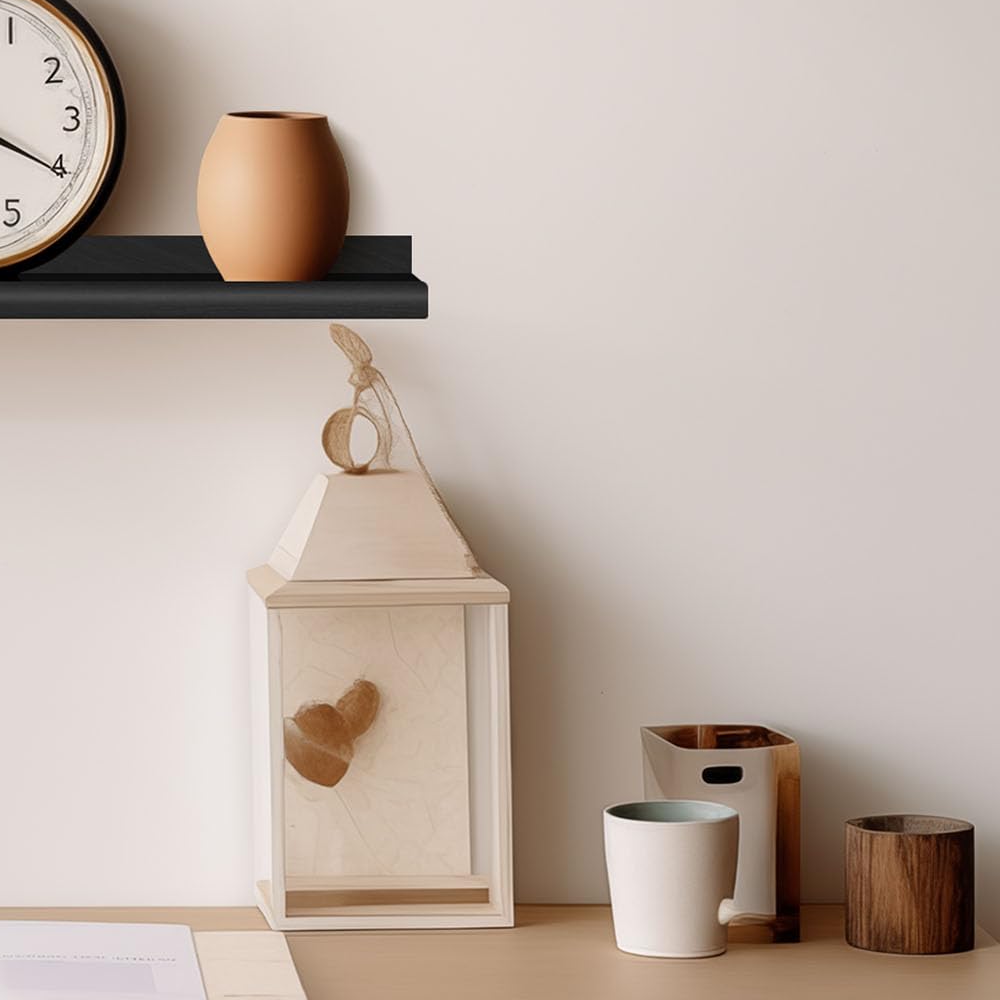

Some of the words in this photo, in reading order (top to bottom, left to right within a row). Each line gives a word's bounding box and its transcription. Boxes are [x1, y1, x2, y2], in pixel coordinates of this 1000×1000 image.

[8, 16, 14, 44] 1
[43, 57, 63, 84] 2
[62, 106, 80, 132] 3
[2, 199, 21, 227] 5
